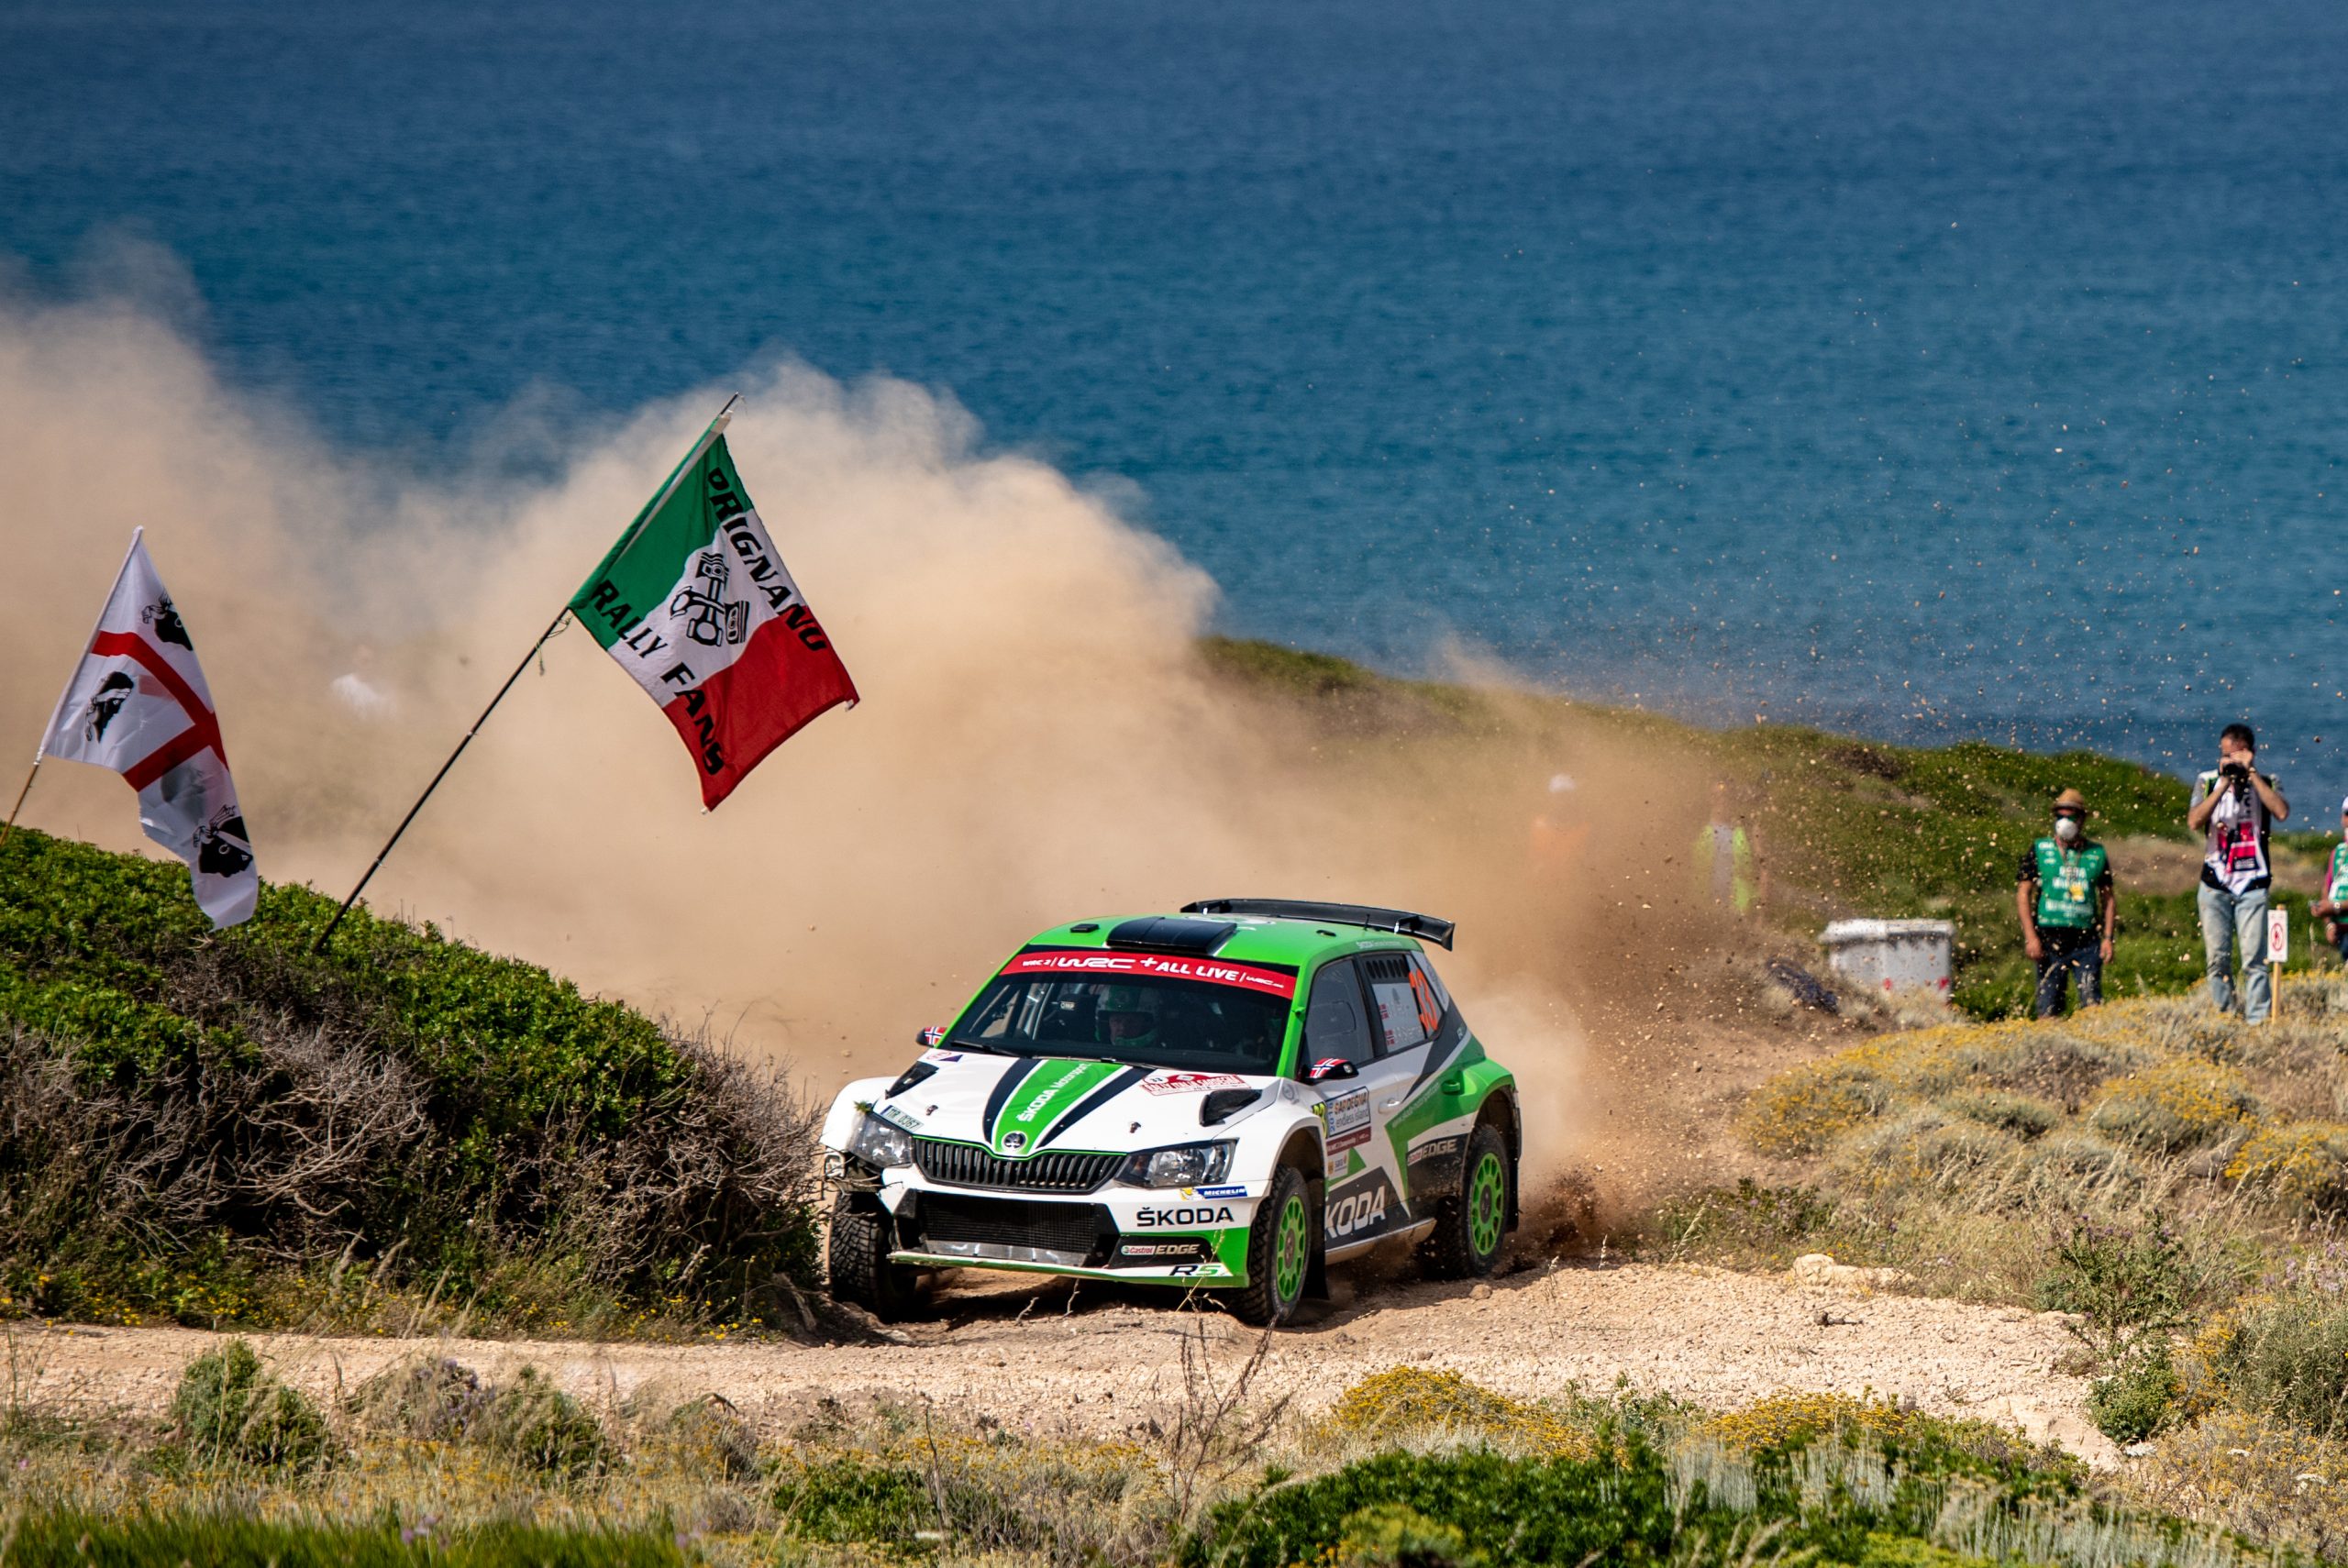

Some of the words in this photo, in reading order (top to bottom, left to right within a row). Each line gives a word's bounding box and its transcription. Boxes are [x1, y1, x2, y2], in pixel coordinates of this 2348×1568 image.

[591, 580, 668, 658] RALLY
[660, 661, 725, 776] FANS
[1058, 957, 1135, 969] WRC
[1155, 962, 1191, 974] ALL
[1196, 966, 1239, 981] LIVE
[1016, 1088, 1058, 1122] ŠKODA
[1136, 1207, 1234, 1227] ŠKODA
[1325, 1186, 1386, 1238] KODA
[1129, 1245, 1154, 1253] Castrol
[1155, 1243, 1201, 1254] EDGE
